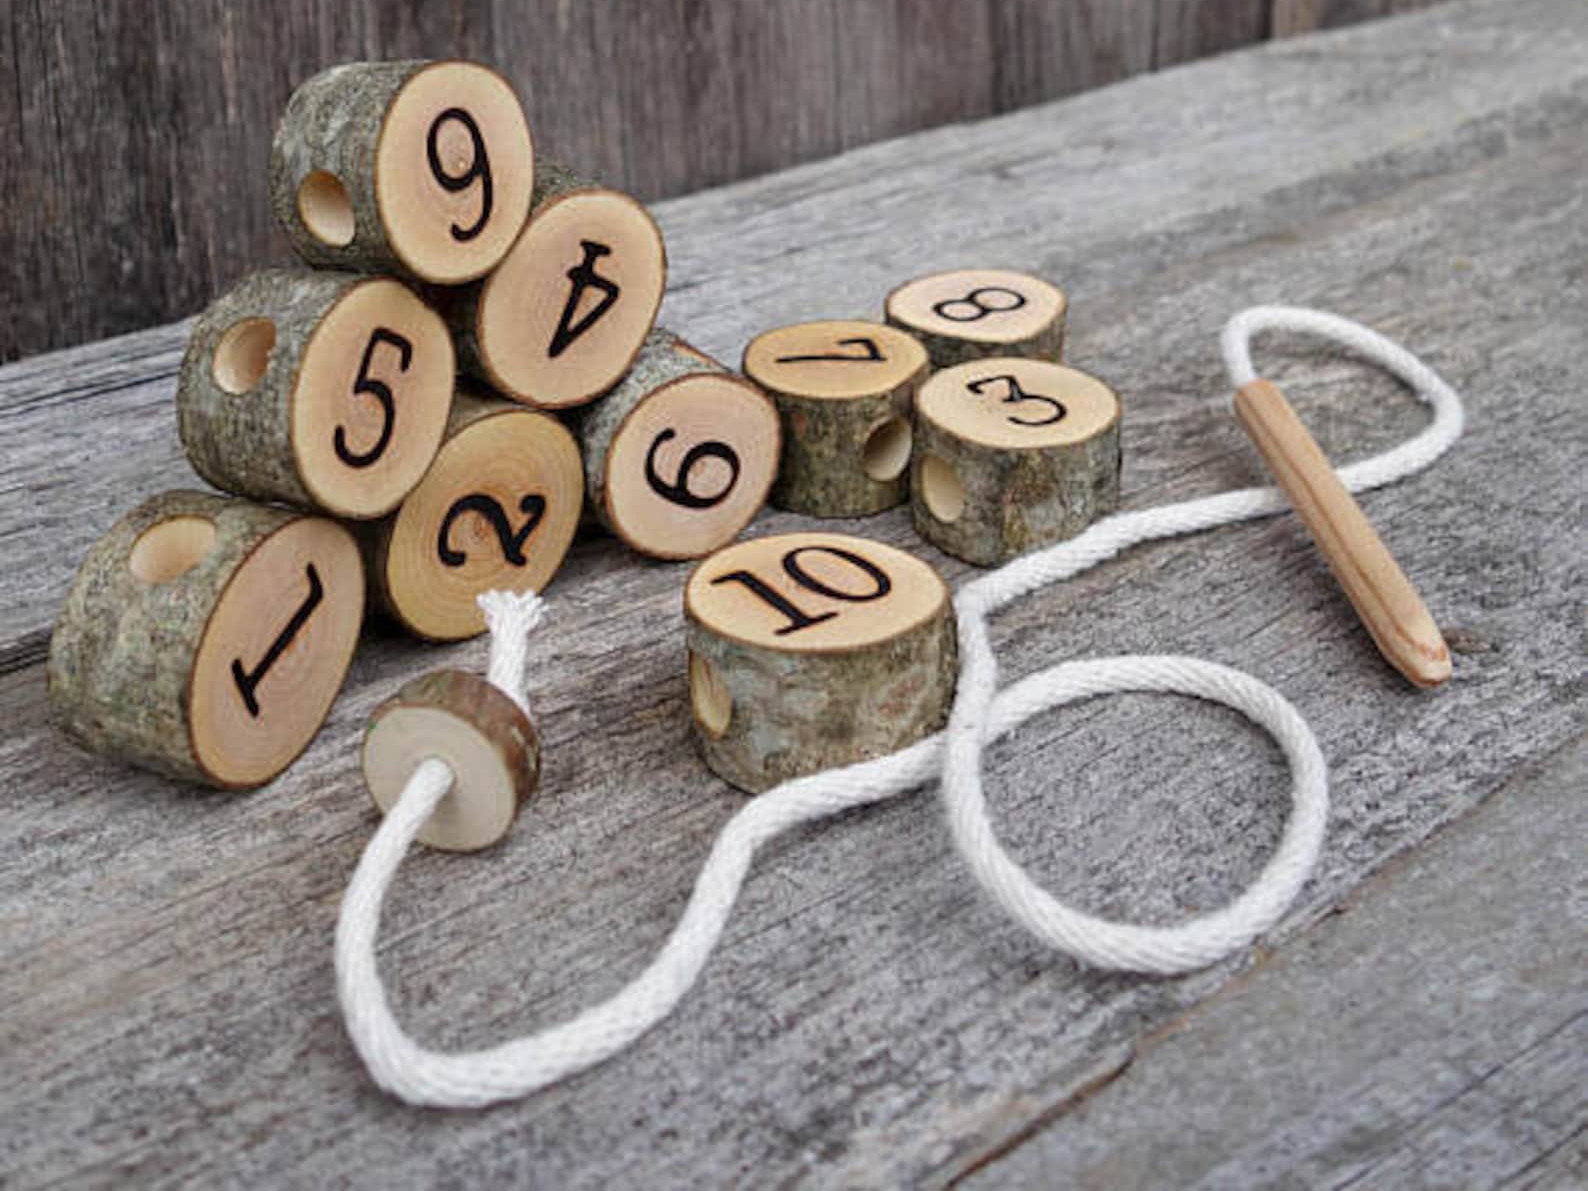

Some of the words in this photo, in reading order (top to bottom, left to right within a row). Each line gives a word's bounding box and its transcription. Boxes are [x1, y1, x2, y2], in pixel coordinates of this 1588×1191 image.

[426, 107, 494, 243] 9
[547, 239, 620, 359] 4
[933, 286, 1026, 323] 8
[774, 337, 887, 365] 7
[332, 326, 413, 470] 5
[967, 374, 1067, 427] 3
[644, 427, 741, 510] 6
[436, 491, 547, 568] 2
[710, 545, 893, 636] 10
[230, 561, 324, 719] 1
